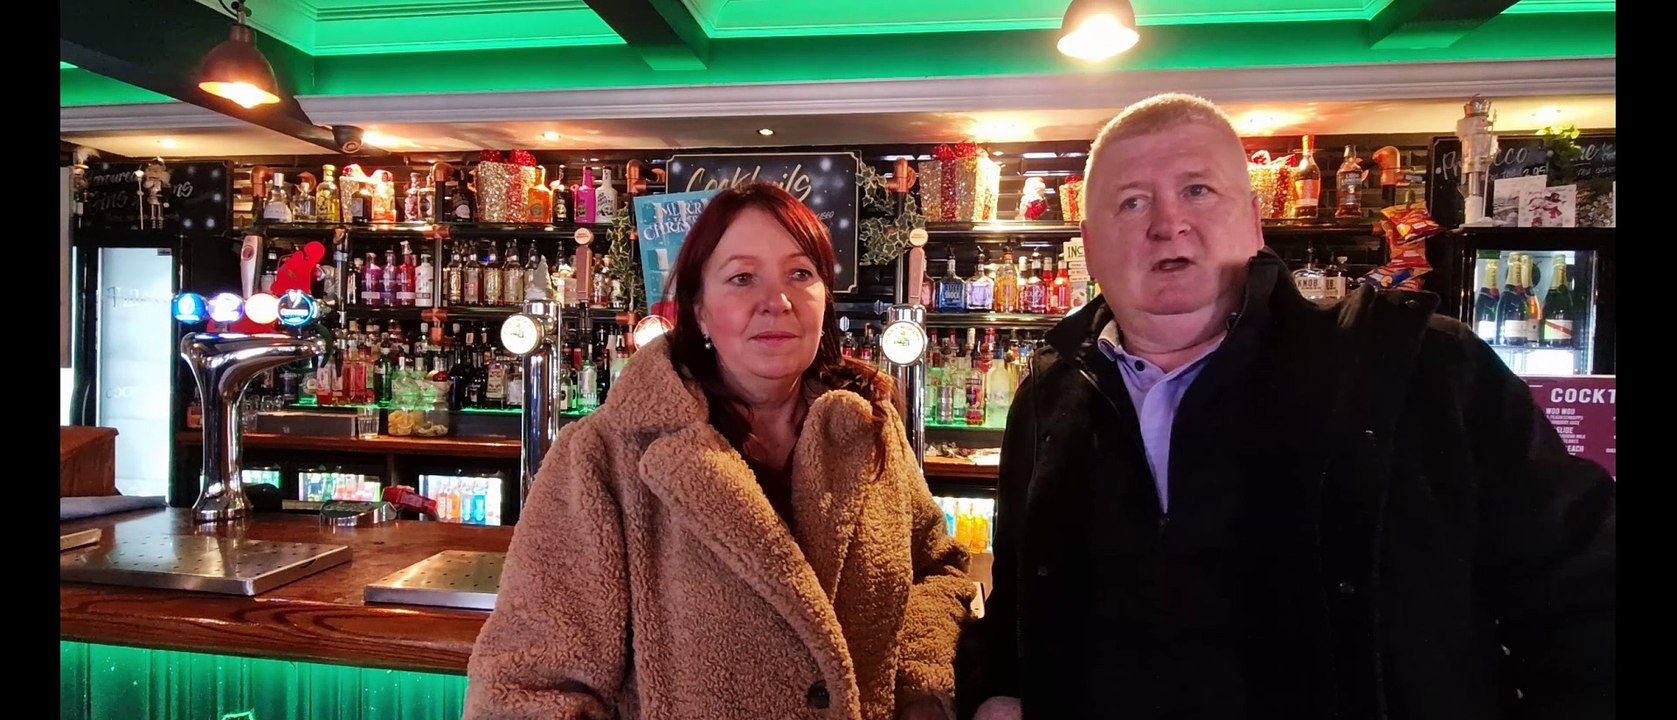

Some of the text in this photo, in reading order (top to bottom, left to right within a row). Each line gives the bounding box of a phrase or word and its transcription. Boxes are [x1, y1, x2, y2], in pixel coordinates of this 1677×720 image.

[1550, 387, 1616, 404] COCKT
[1556, 426, 1574, 434] SLIDE
[1566, 445, 1585, 453] EACH
